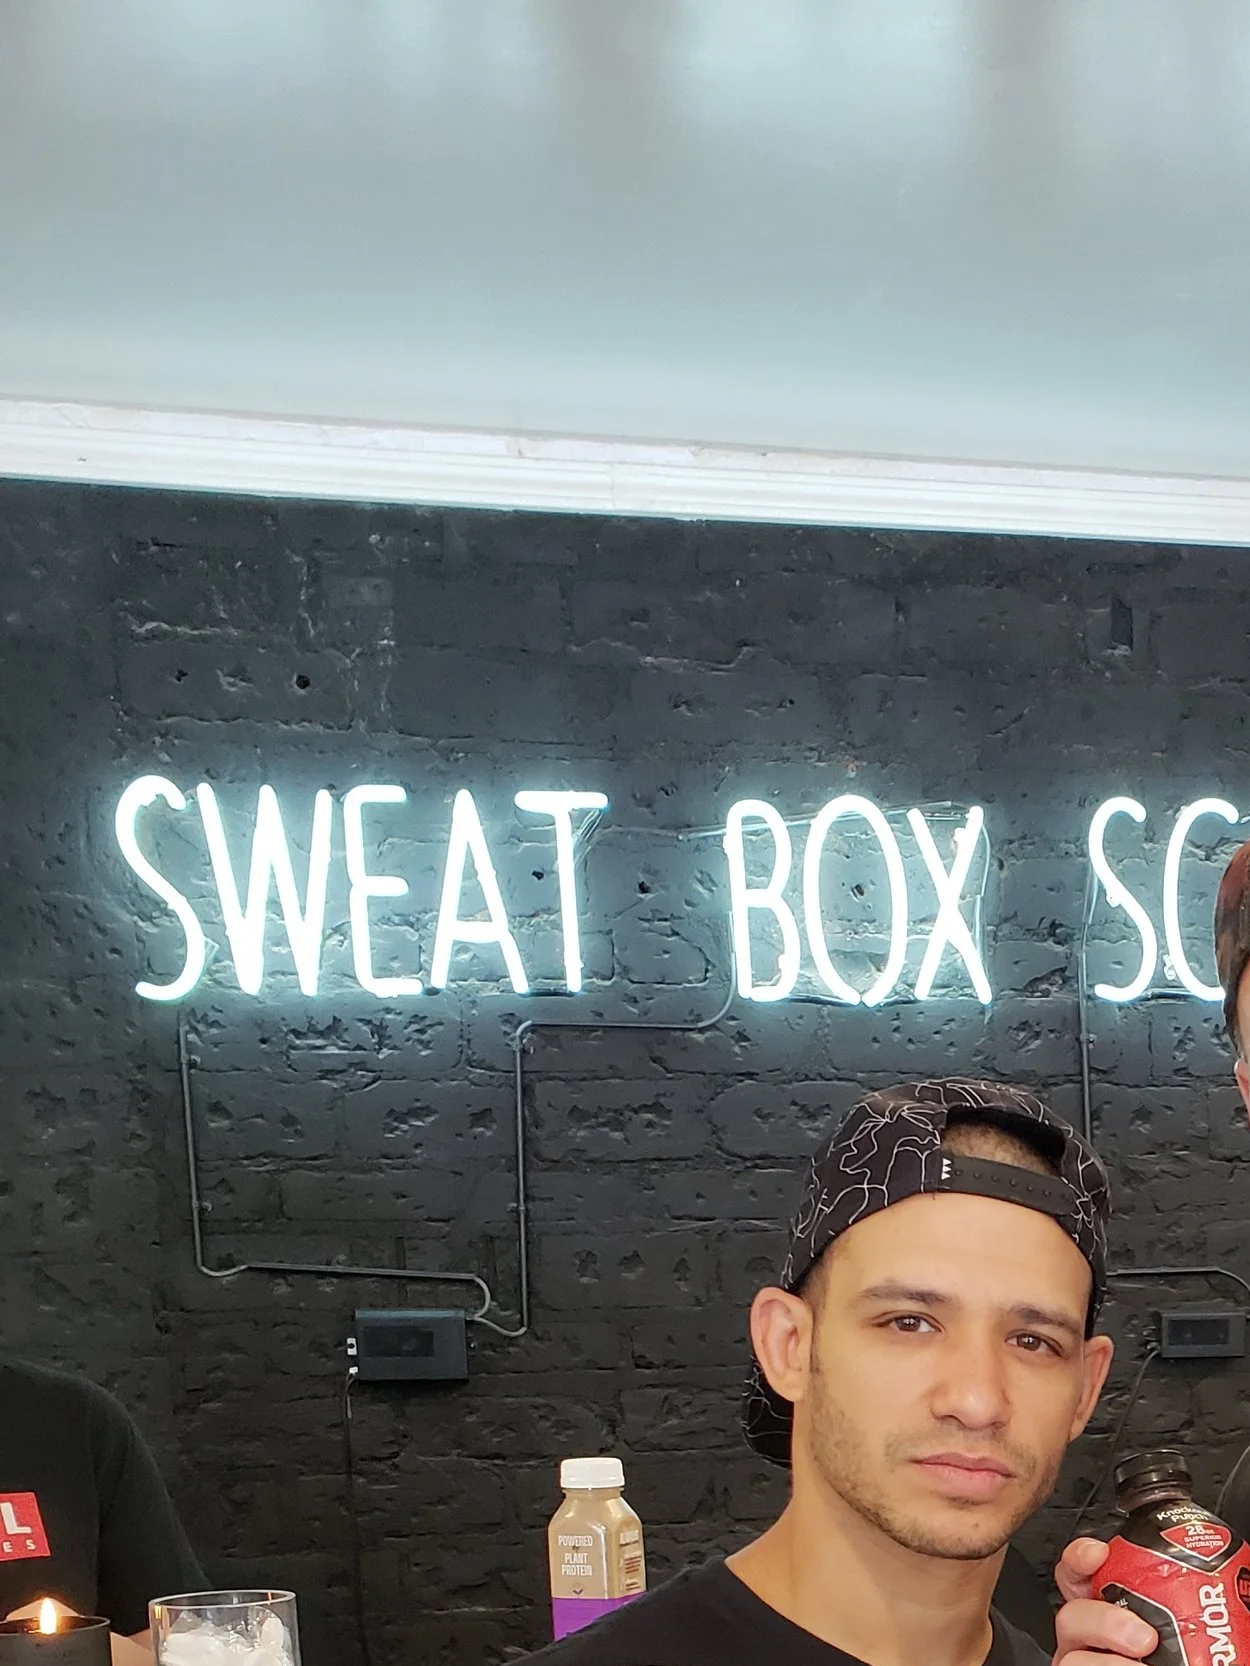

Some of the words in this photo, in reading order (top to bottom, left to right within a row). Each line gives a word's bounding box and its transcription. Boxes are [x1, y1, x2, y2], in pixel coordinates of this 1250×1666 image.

[115, 774, 608, 1002] SWEAT
[723, 794, 993, 1006] BOX
[557, 1535, 594, 1547] POWERED
[564, 1552, 588, 1564] PLANT
[561, 1564, 593, 1576] PROTEIN
